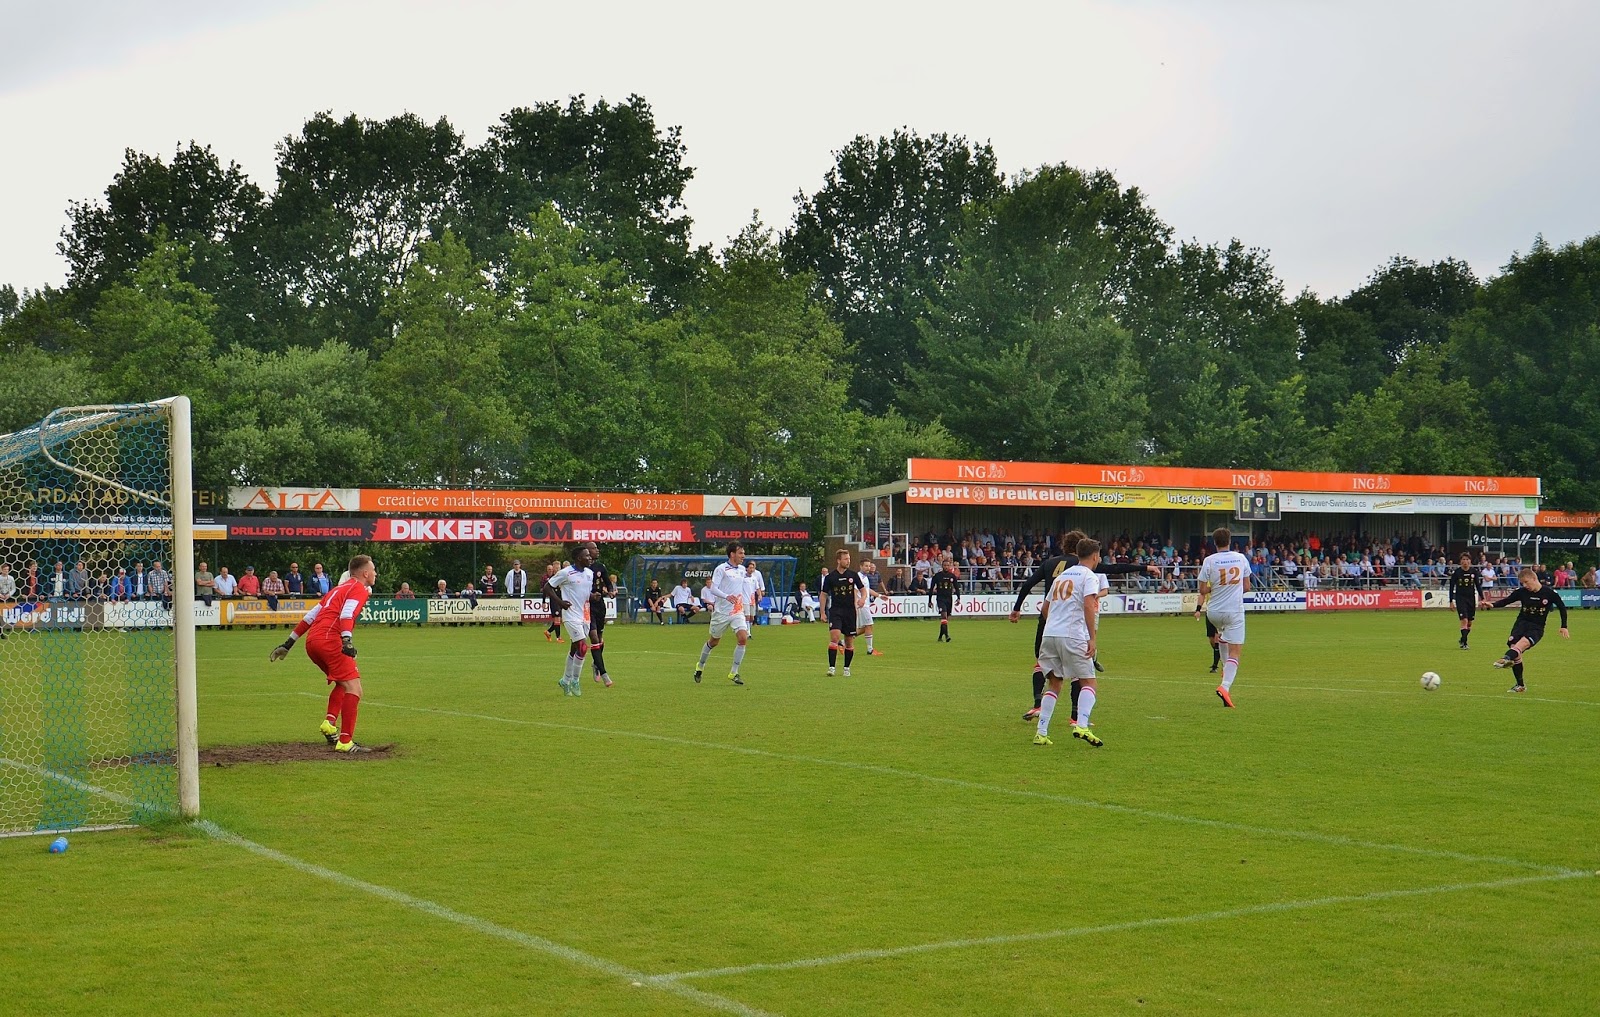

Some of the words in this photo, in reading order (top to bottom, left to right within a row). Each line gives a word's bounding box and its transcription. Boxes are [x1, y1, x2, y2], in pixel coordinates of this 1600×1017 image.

[958, 465, 986, 478] ING
[1101, 470, 1127, 483] ING
[1232, 474, 1256, 487] ING
[1353, 478, 1375, 490] ING
[1464, 480, 1485, 492] ING
[243, 488, 346, 511] ALTA
[907, 485, 970, 501] expert
[988, 486, 1074, 502] Breukelen
[1076, 489, 1124, 505] Intertoys
[1166, 492, 1213, 507] Intertoys
[378, 491, 439, 507] creatieve
[444, 491, 611, 512] marketingcommunicatie
[623, 498, 642, 510] 030
[646, 499, 689, 511] 2312356
[718, 496, 800, 517] ALTA
[230, 526, 277, 536] DRILLED
[279, 527, 295, 536] TO
[296, 528, 362, 537] PERFECTION
[573, 530, 682, 541] BETONBORINGEN
[705, 530, 741, 539] DRILLED
[743, 531, 755, 539] TO
[756, 531, 809, 540] PERFECTION
[684, 570, 713, 578] GASTEN
[1052, 561, 1068, 578] 4
[1218, 566, 1241, 586] 12
[1052, 579, 1074, 602] 10
[236, 602, 262, 611] AUTO
